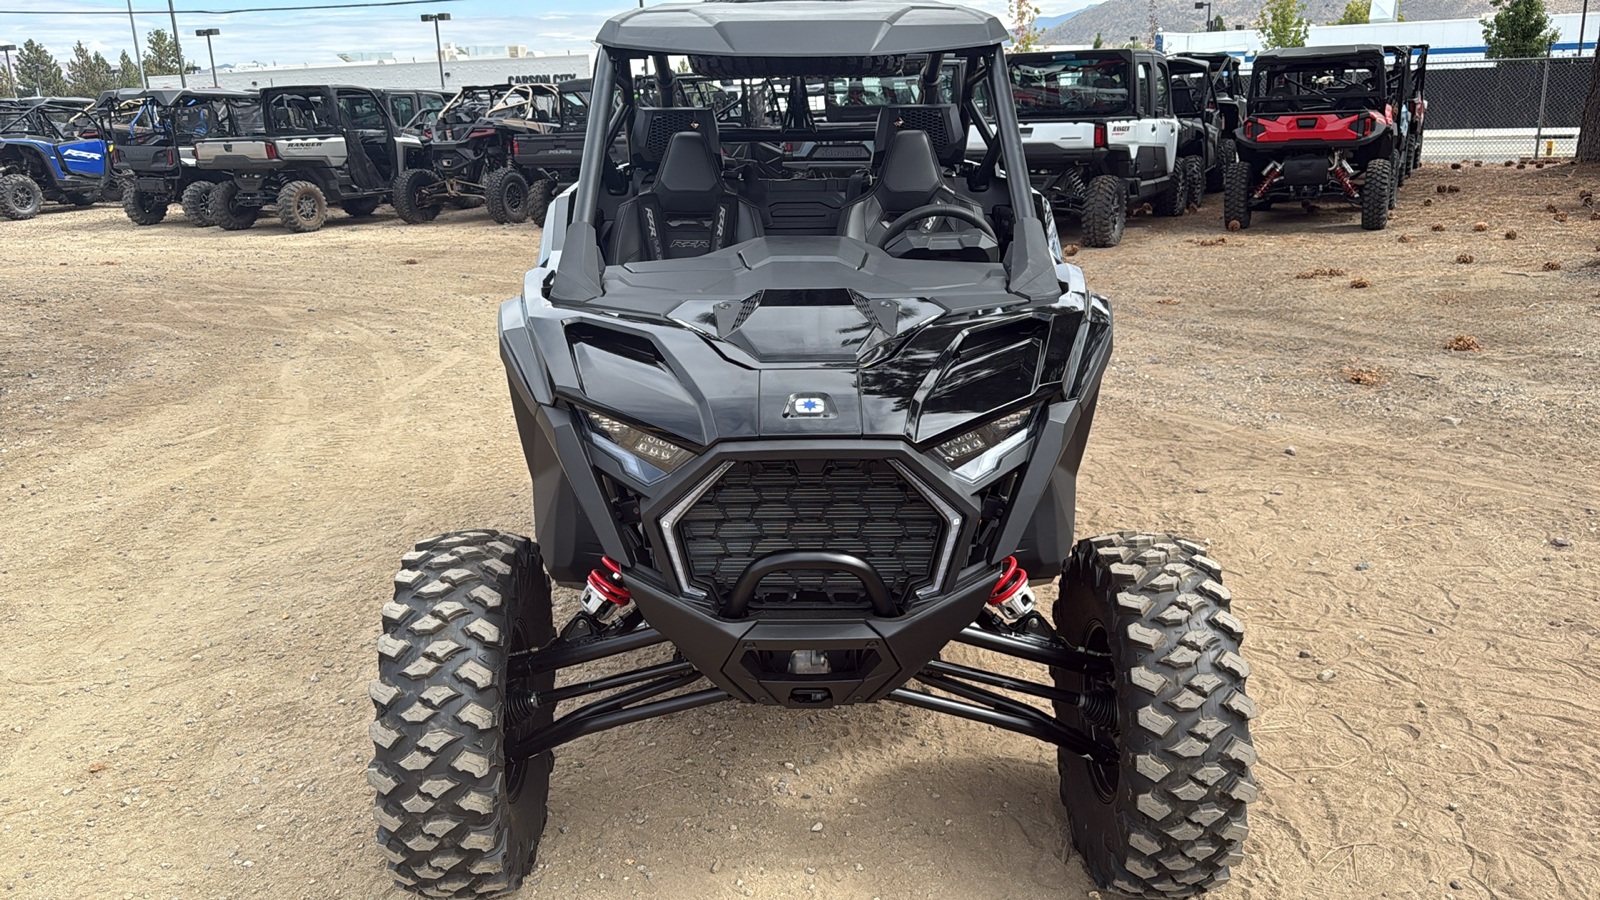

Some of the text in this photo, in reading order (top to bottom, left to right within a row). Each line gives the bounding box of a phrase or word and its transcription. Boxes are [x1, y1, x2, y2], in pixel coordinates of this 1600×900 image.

[508, 74, 550, 84] CARSON
[63, 149, 101, 160] RZR
[822, 148, 862, 156] Kawasaki
[645, 207, 657, 237] RZR
[717, 206, 726, 237] RZR
[670, 239, 710, 248] RZR
